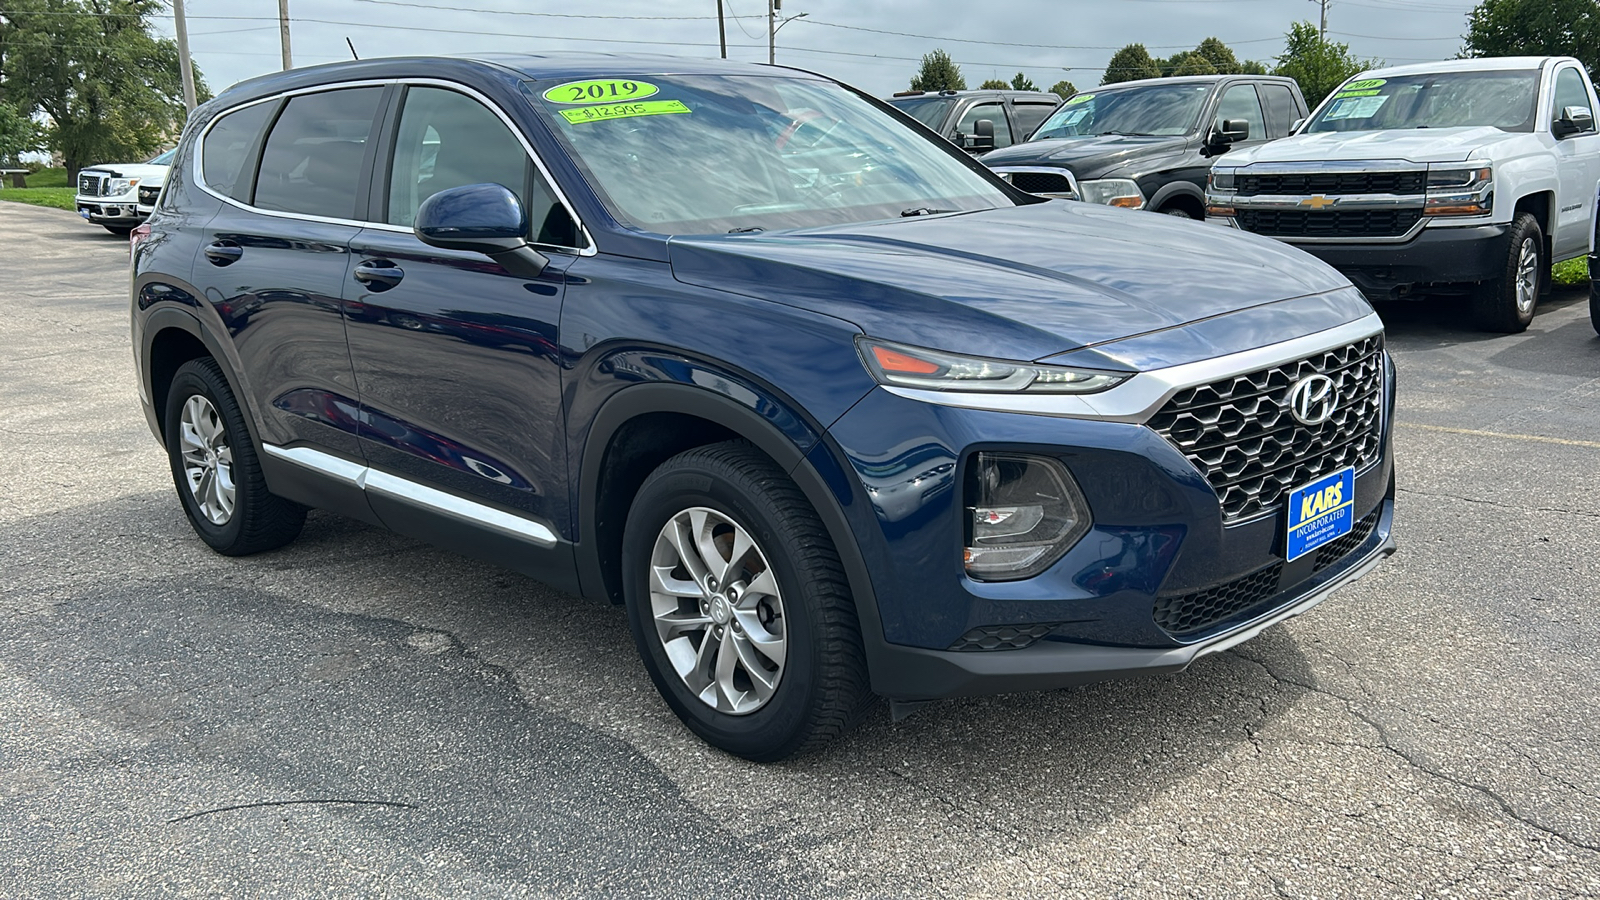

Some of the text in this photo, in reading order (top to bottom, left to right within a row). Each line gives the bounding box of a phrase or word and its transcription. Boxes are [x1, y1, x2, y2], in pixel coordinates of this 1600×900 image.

[568, 82, 638, 101] 2019
[1300, 481, 1343, 522] KARS
[1296, 509, 1345, 538] INCORPORATED
